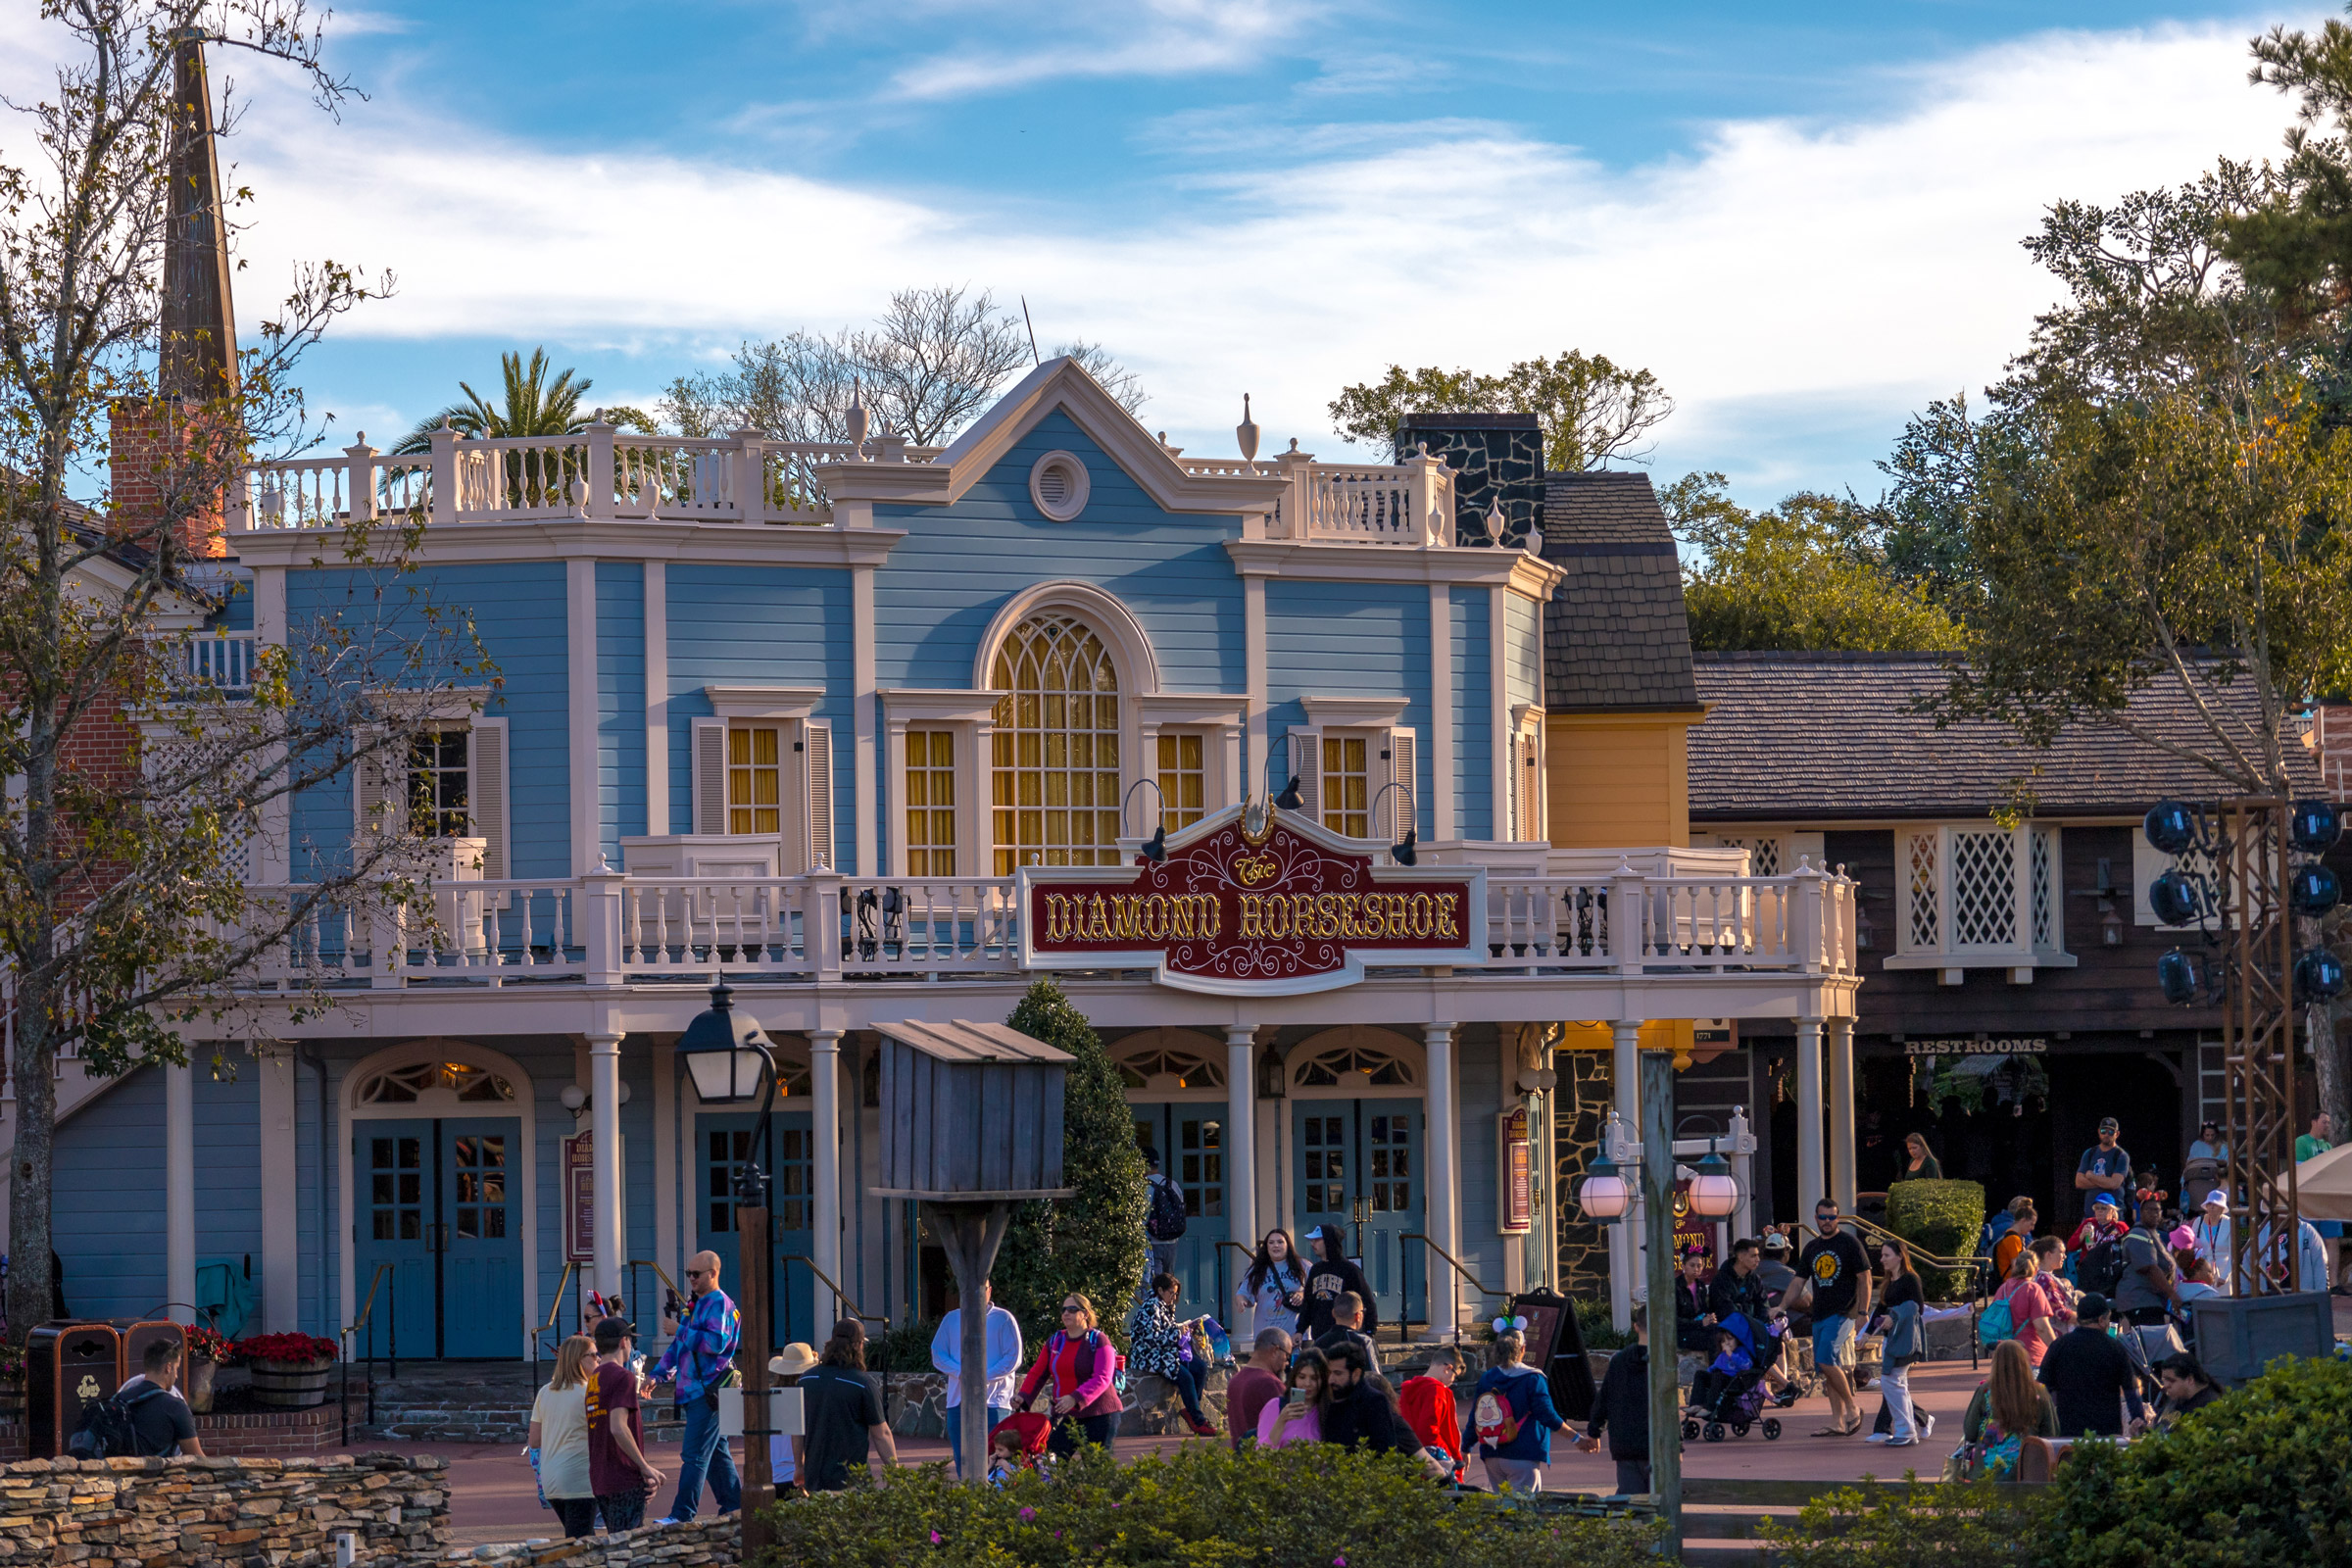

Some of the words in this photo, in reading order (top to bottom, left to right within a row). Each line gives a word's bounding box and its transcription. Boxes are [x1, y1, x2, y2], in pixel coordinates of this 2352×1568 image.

[1235, 855, 1276, 886] The
[1046, 893, 1221, 941] DIAMOND
[1238, 893, 1459, 940] HORSESHOE
[1904, 1039, 2047, 1054] RESTROOMS
[1673, 1232, 1705, 1250] MOND
